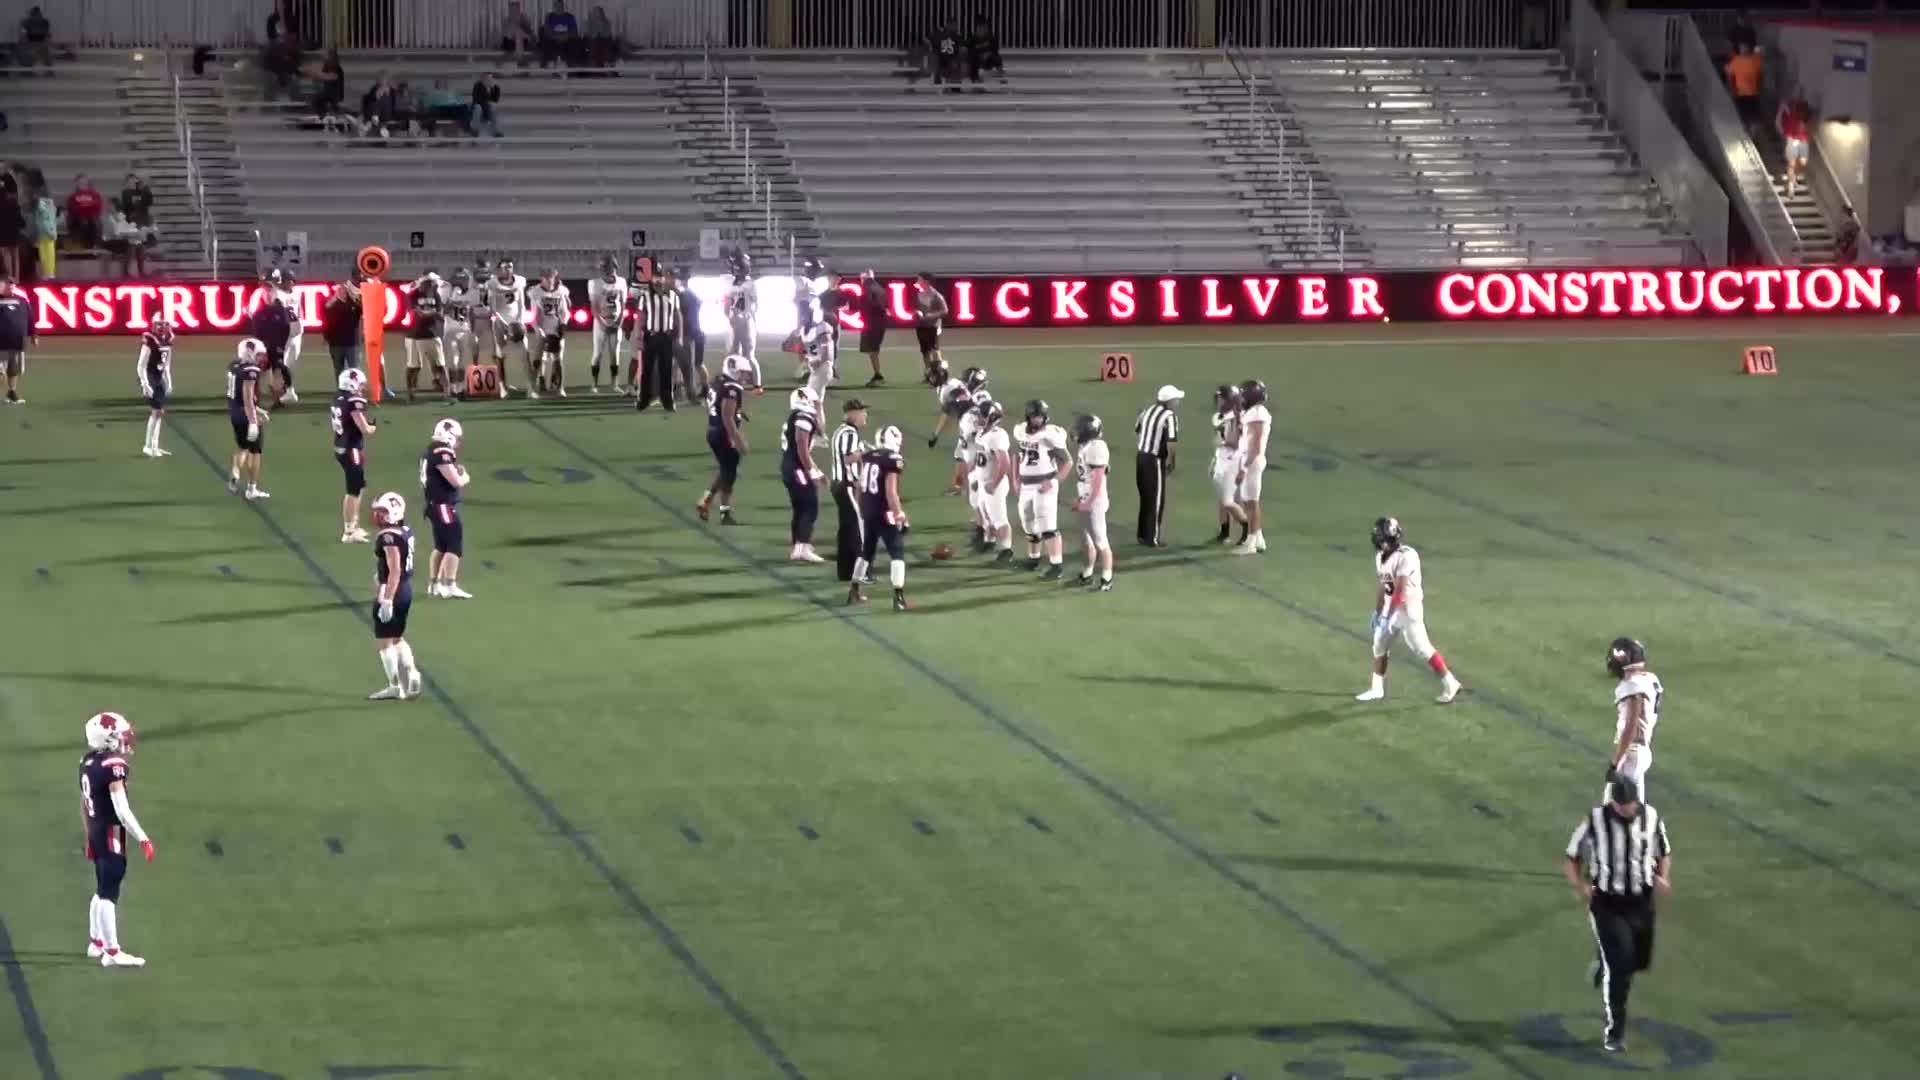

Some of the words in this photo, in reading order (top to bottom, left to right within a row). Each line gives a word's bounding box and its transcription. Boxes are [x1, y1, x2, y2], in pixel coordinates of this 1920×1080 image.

[635, 256, 653, 283] 3
[1439, 267, 1901, 315] CONSTRUCTION,
[1106, 356, 1130, 379] 20
[1749, 350, 1773, 371] 10
[472, 369, 496, 391] 30
